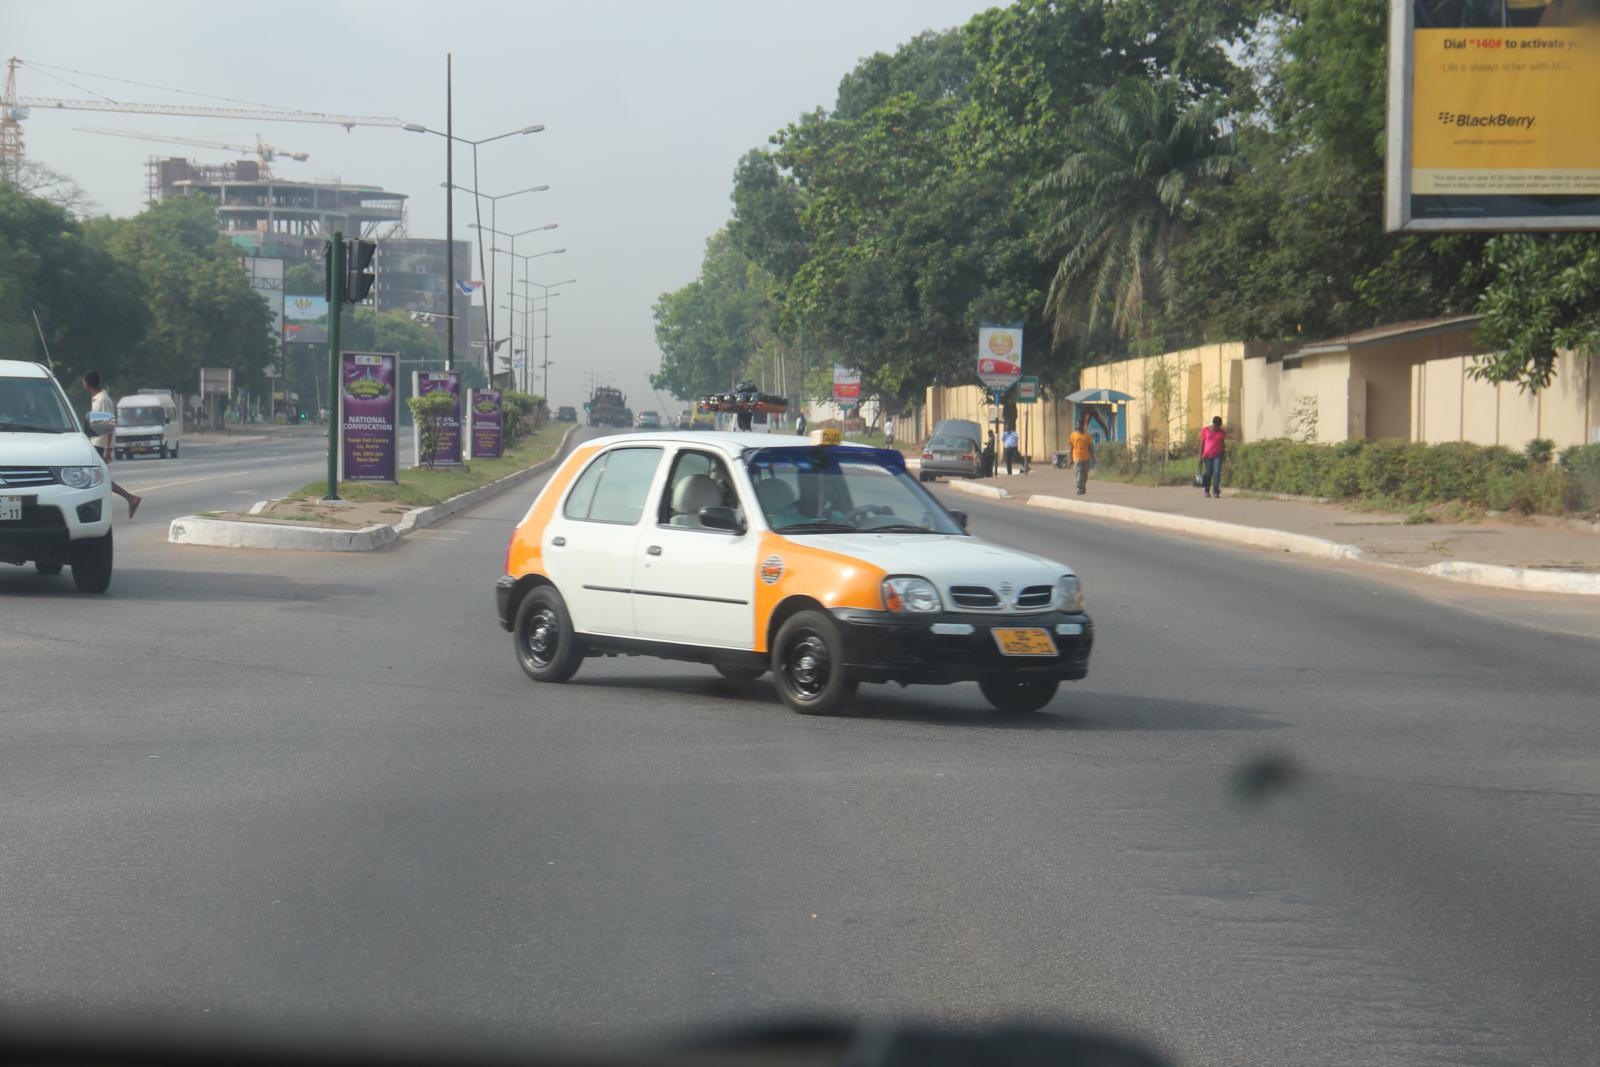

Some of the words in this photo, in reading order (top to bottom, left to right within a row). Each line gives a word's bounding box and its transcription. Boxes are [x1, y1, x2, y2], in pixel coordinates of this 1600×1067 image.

[1443, 39, 1466, 49] Dial
[1505, 39, 1517, 49] to
[1520, 38, 1565, 49] activate
[1456, 113, 1536, 129] BlackBerry
[348, 416, 388, 424] NATIONAL
[343, 423, 393, 431] CONVOCATION
[0, 509, 20, 519] -11
